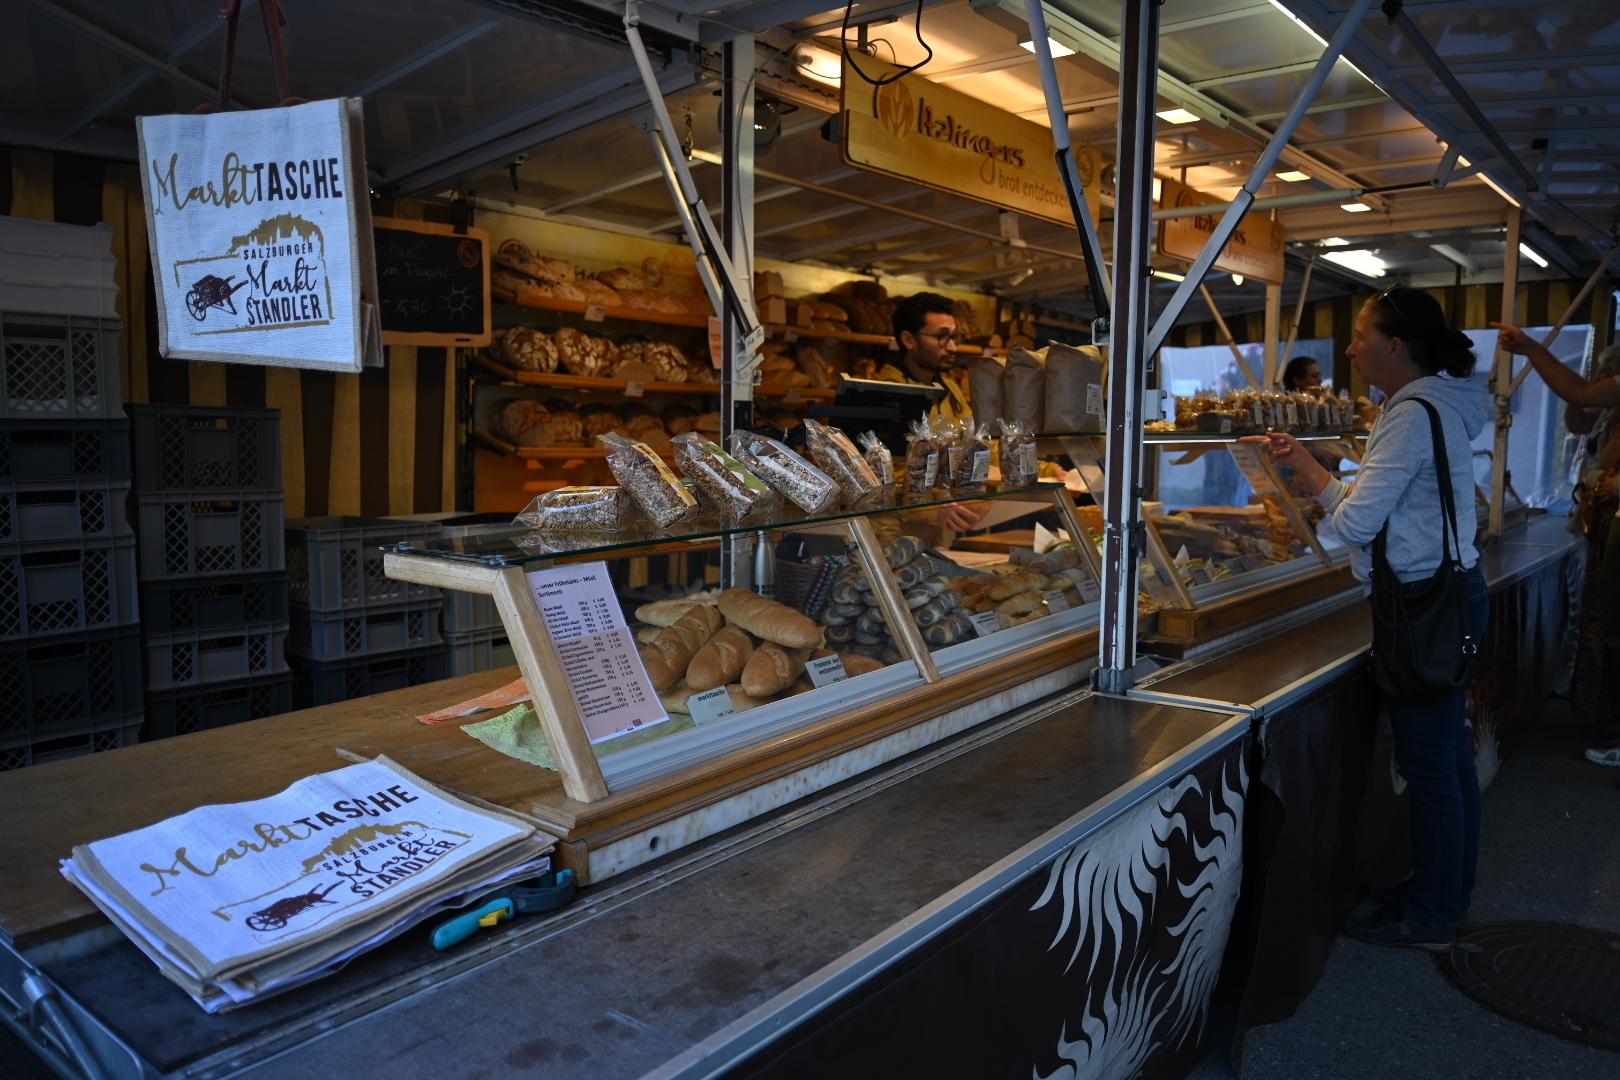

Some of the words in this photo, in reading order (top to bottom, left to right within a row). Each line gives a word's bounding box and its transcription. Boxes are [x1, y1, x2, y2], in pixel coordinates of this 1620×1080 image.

[999, 169, 1021, 194] brot
[244, 243, 313, 260] SALZBURGER
[246, 257, 317, 300] Markt
[246, 294, 323, 325] STANDLER
[323, 830, 413, 871] SALZBURGER
[336, 833, 435, 888] Markt
[351, 840, 457, 897] STANDLER
